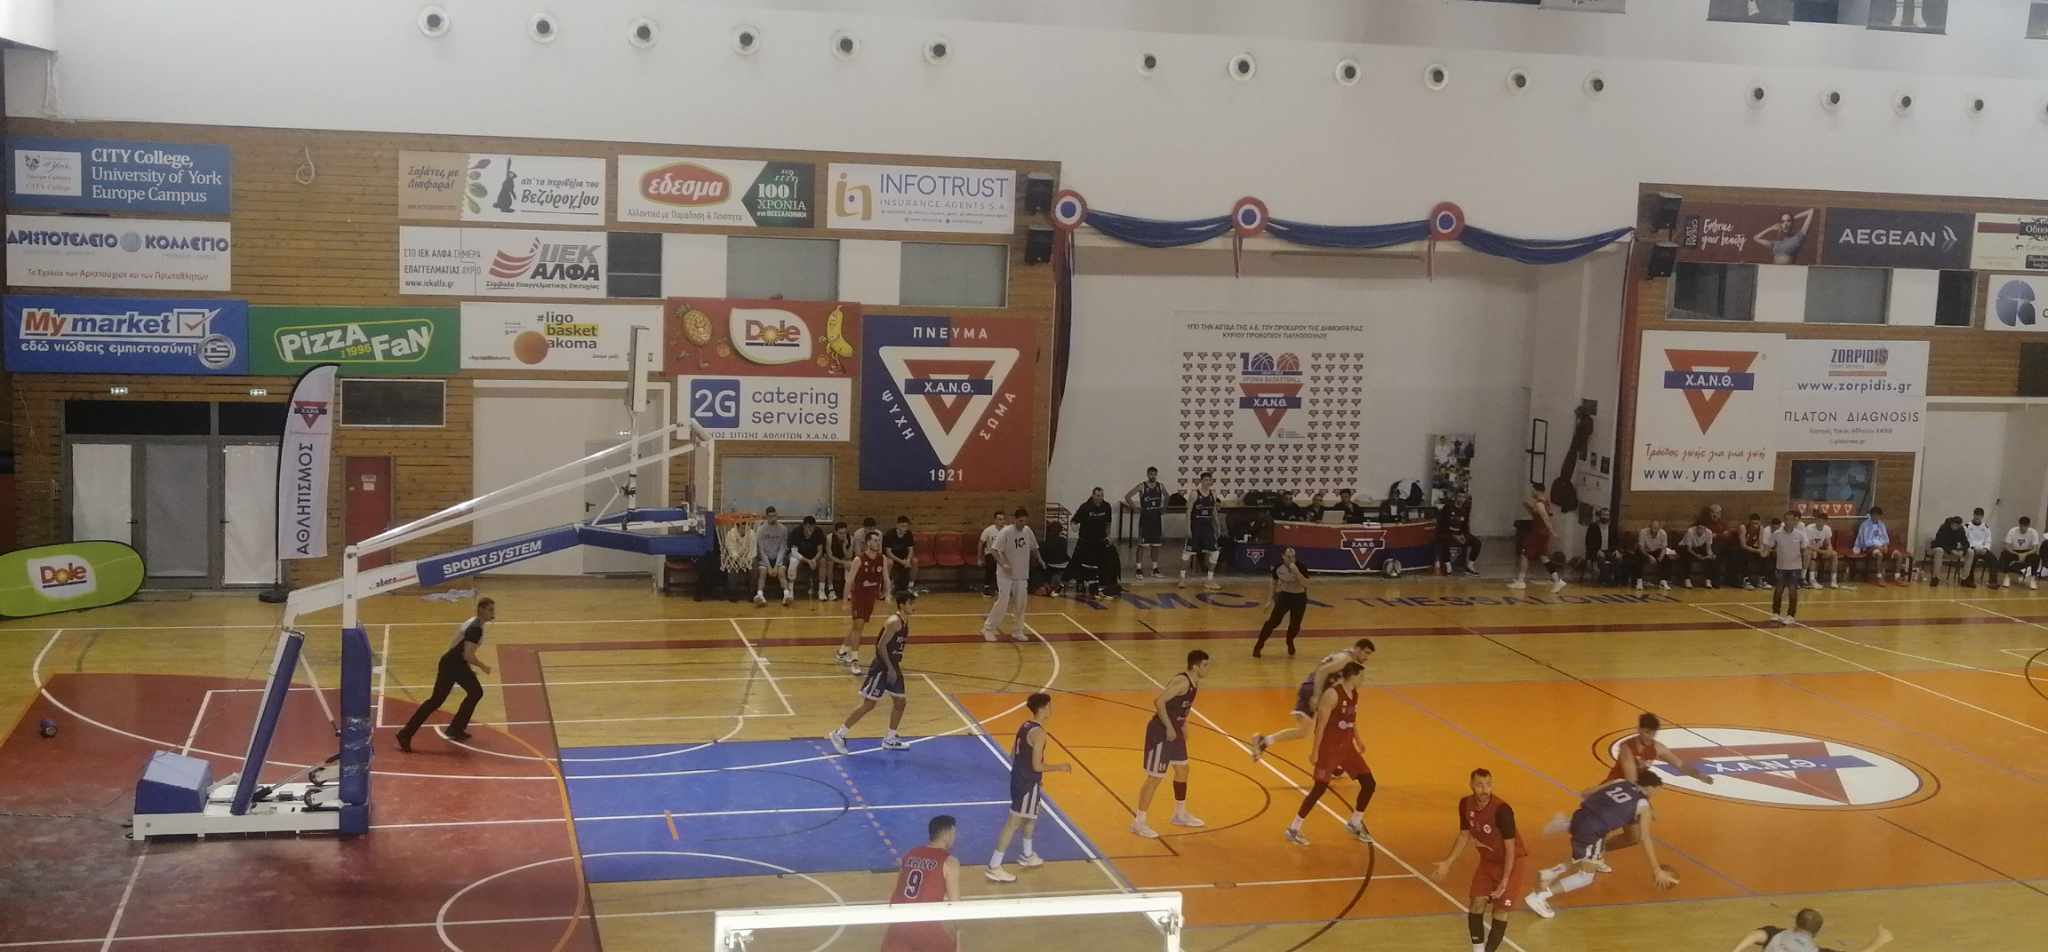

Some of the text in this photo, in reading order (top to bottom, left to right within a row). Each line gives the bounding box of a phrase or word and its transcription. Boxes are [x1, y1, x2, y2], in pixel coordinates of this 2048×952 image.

[92, 148, 193, 169] CITY College,
[92, 166, 222, 186] University of York
[757, 183, 790, 200] 100
[880, 173, 1009, 198] INFOTRUST
[92, 185, 145, 203] Europe
[148, 186, 207, 205] Campus
[757, 200, 807, 212] ΧΡΟΝΙΑ
[7, 230, 229, 252] ΑΡΙΣΤΟΤΕΛΕΙΟ ΚΟΛΛΕΓΙΟ
[1839, 228, 1936, 247] AEGEAN
[530, 263, 600, 281] ΑΛΦΑ
[24, 311, 171, 336] My market
[537, 311, 574, 326] #ligo
[547, 324, 598, 337] basket
[745, 319, 801, 345] Dole
[912, 326, 989, 340] ΠΝΕΥΜΑ
[21, 341, 197, 357] εδώ νιώθεις εμπιστοσύνη!
[548, 337, 598, 350] akoma
[1830, 348, 1889, 365] ZORPIDIS
[924, 382, 975, 393] Χ.Α.Ν.Θ.
[1685, 374, 1734, 387] Χ.Α.Ν.Θ.
[1797, 379, 1912, 394] www.zorpidis.gr
[695, 388, 736, 419] 2G
[751, 387, 839, 410] catering
[751, 407, 839, 425] services
[881, 390, 915, 441] ΨΥΧΗ
[979, 391, 1017, 441] ΣΩΜΑ
[929, 468, 964, 482] 1921
[1643, 469, 1765, 483] www.ymca.gr
[297, 443, 313, 555] ΑΘΛΗΤΙΣΜΟΣ
[40, 562, 87, 584] Dole
[1605, 786, 1632, 804] 10
[903, 869, 923, 899] 9
